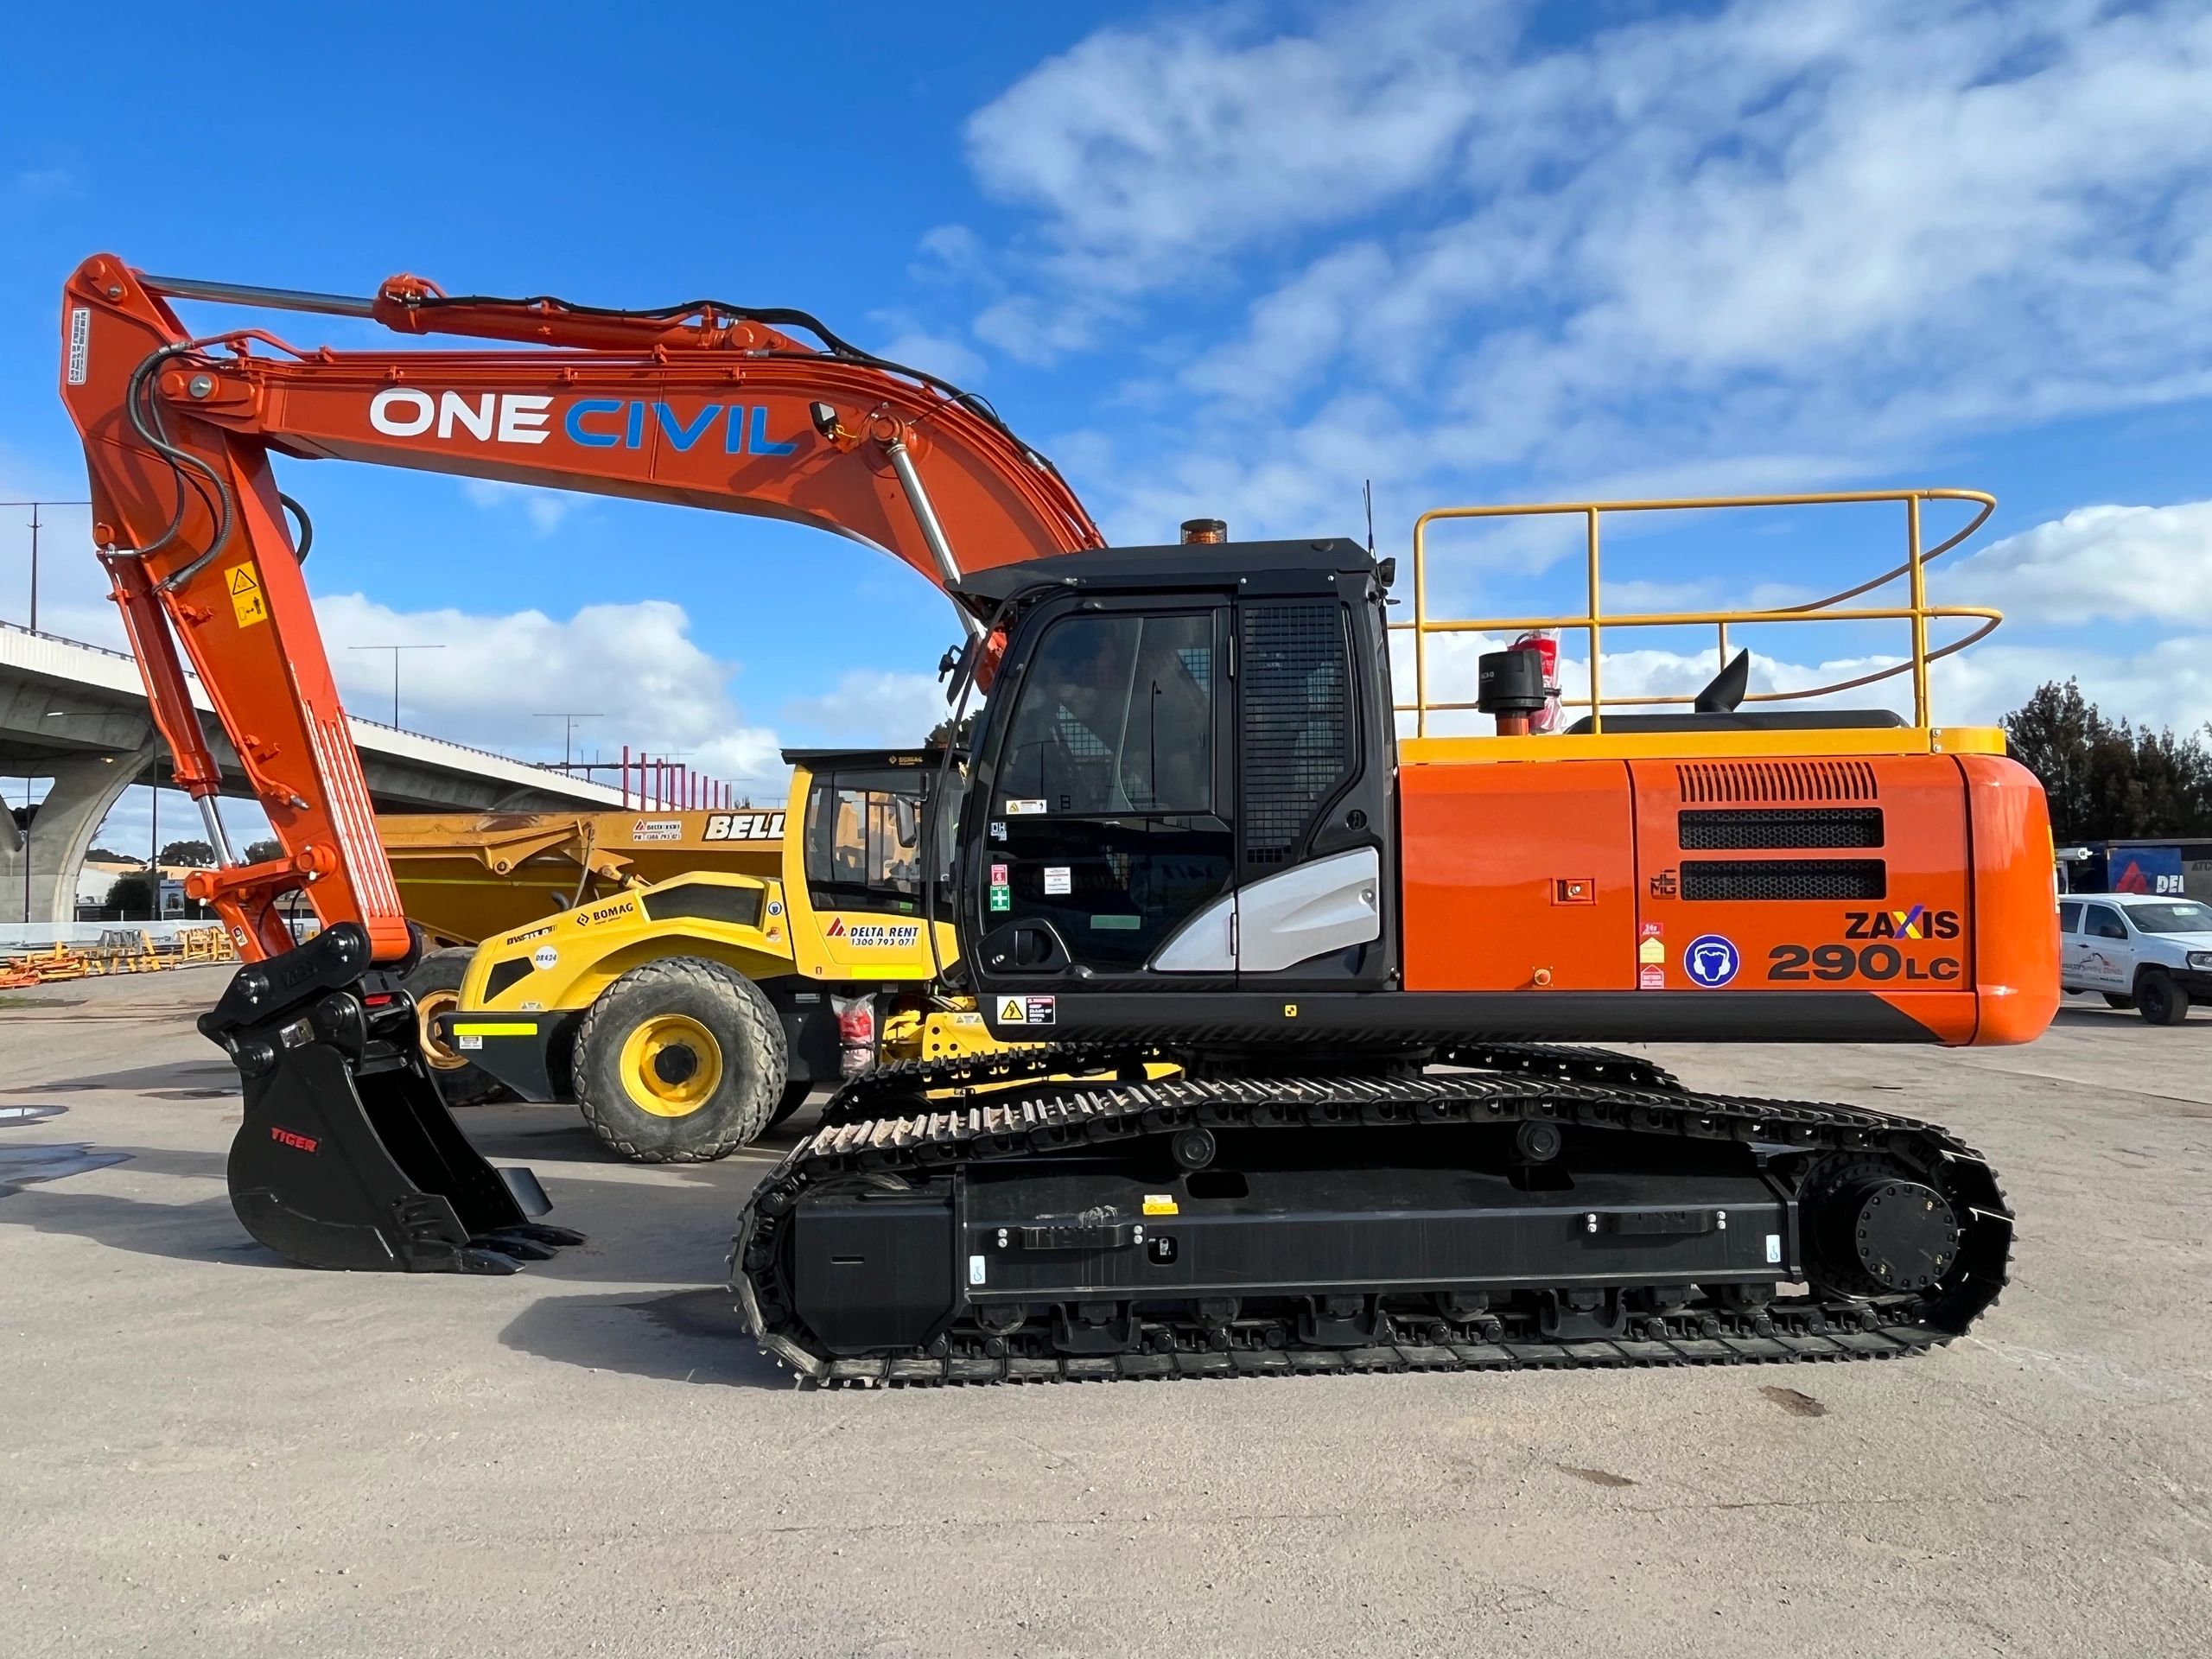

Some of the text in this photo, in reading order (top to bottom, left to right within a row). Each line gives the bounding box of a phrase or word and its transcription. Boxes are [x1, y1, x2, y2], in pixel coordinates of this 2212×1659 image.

[370, 387, 798, 457] ONE CIVIL
[704, 814, 785, 840] BELL
[593, 902, 634, 921] BOMAG
[1845, 905, 1960, 939] ZAXIS
[850, 927, 918, 937] DELTA RENT
[851, 938, 874, 946] 1300
[877, 938, 895, 946] 793
[270, 1127, 318, 1153] TIGER
